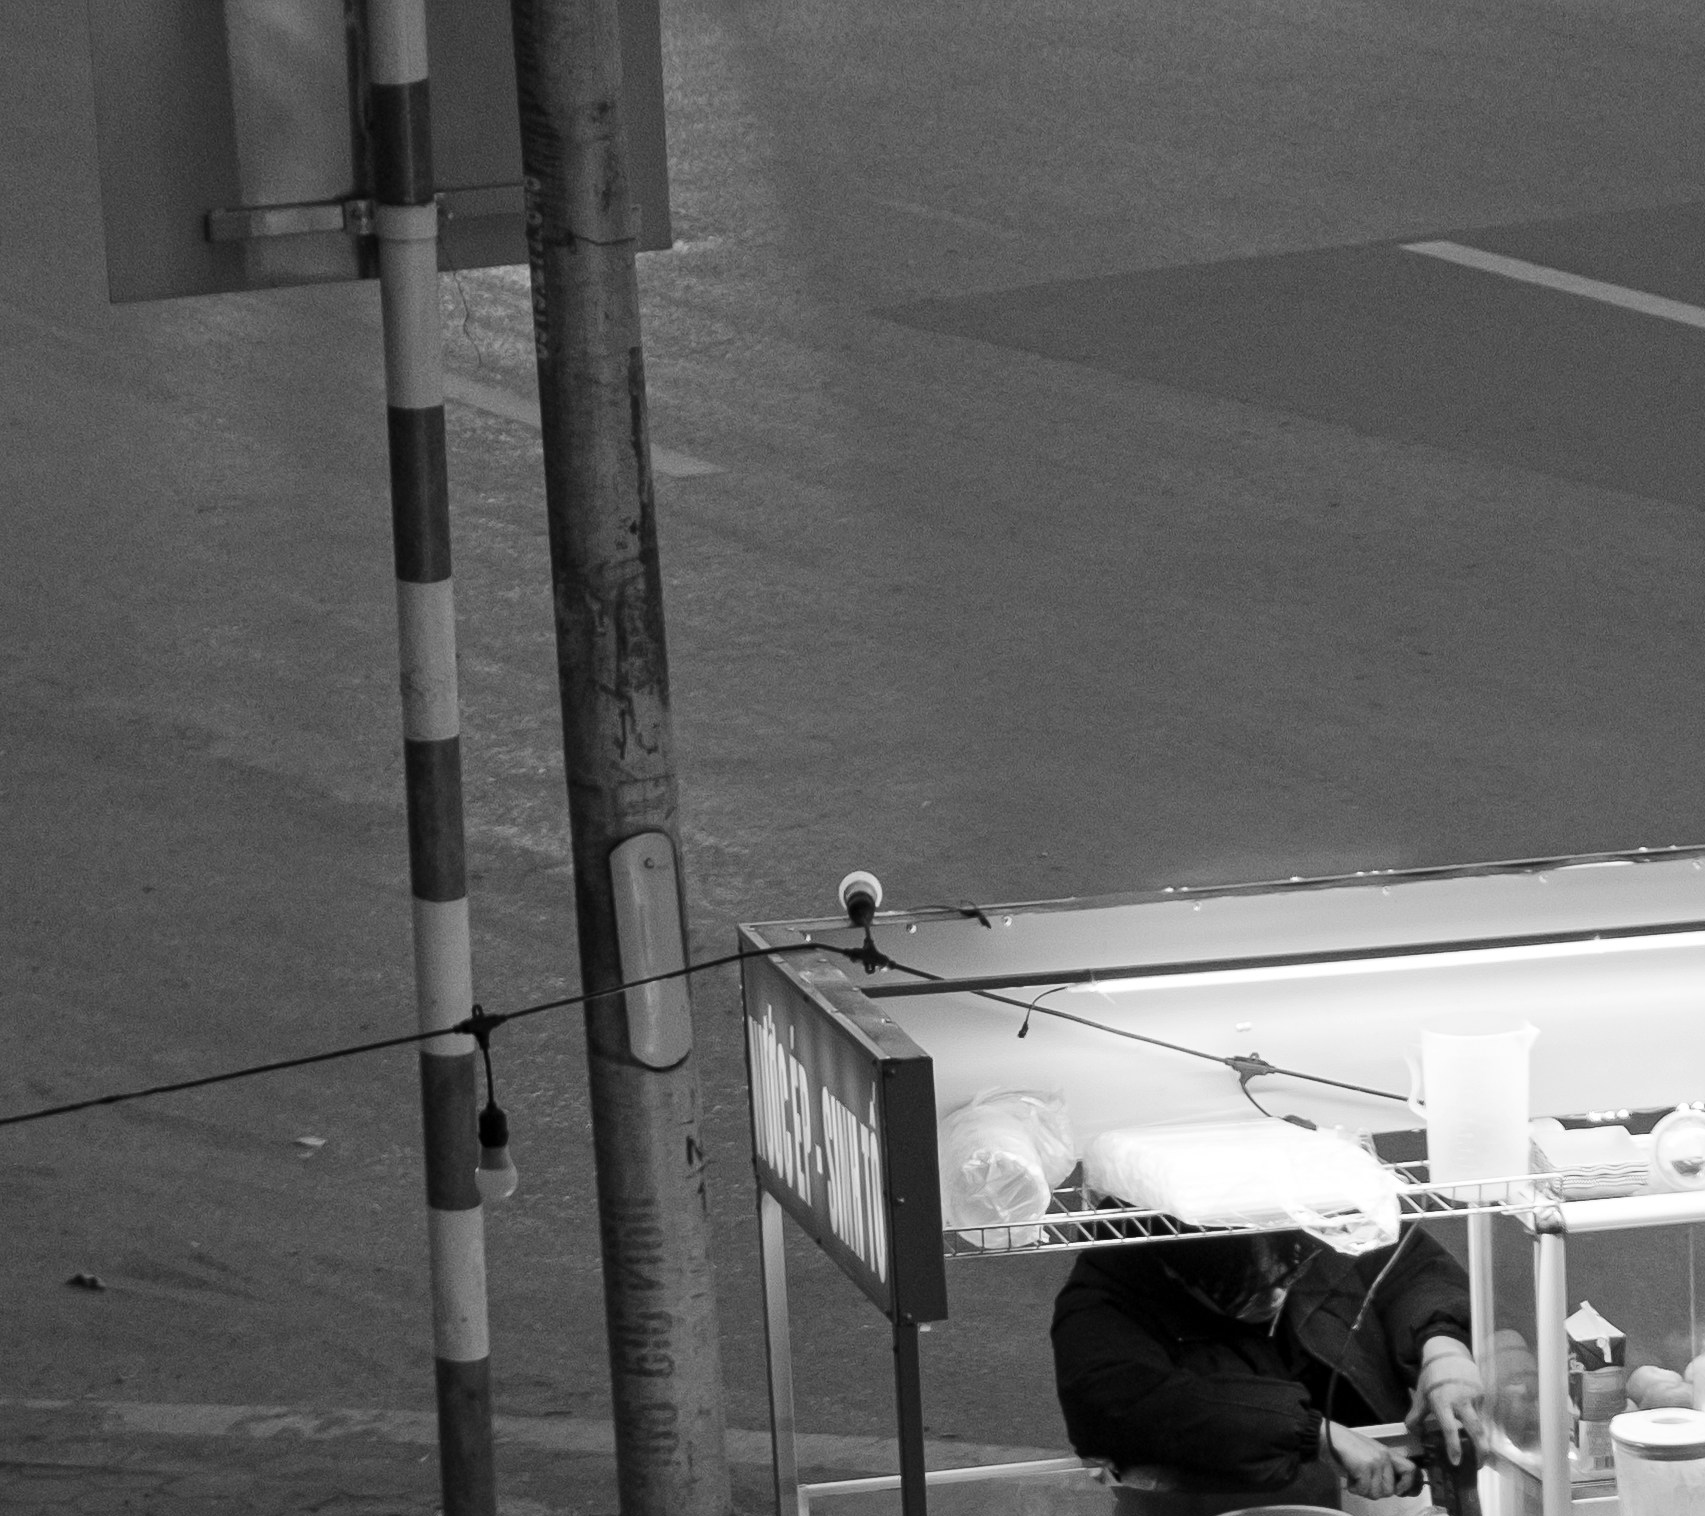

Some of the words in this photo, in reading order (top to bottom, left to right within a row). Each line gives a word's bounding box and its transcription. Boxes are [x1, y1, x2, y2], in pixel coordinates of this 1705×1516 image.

[789, 1024, 812, 1208] ÉP
[822, 1086, 865, 1263] SINH
[860, 1081, 887, 1284] TỐ
